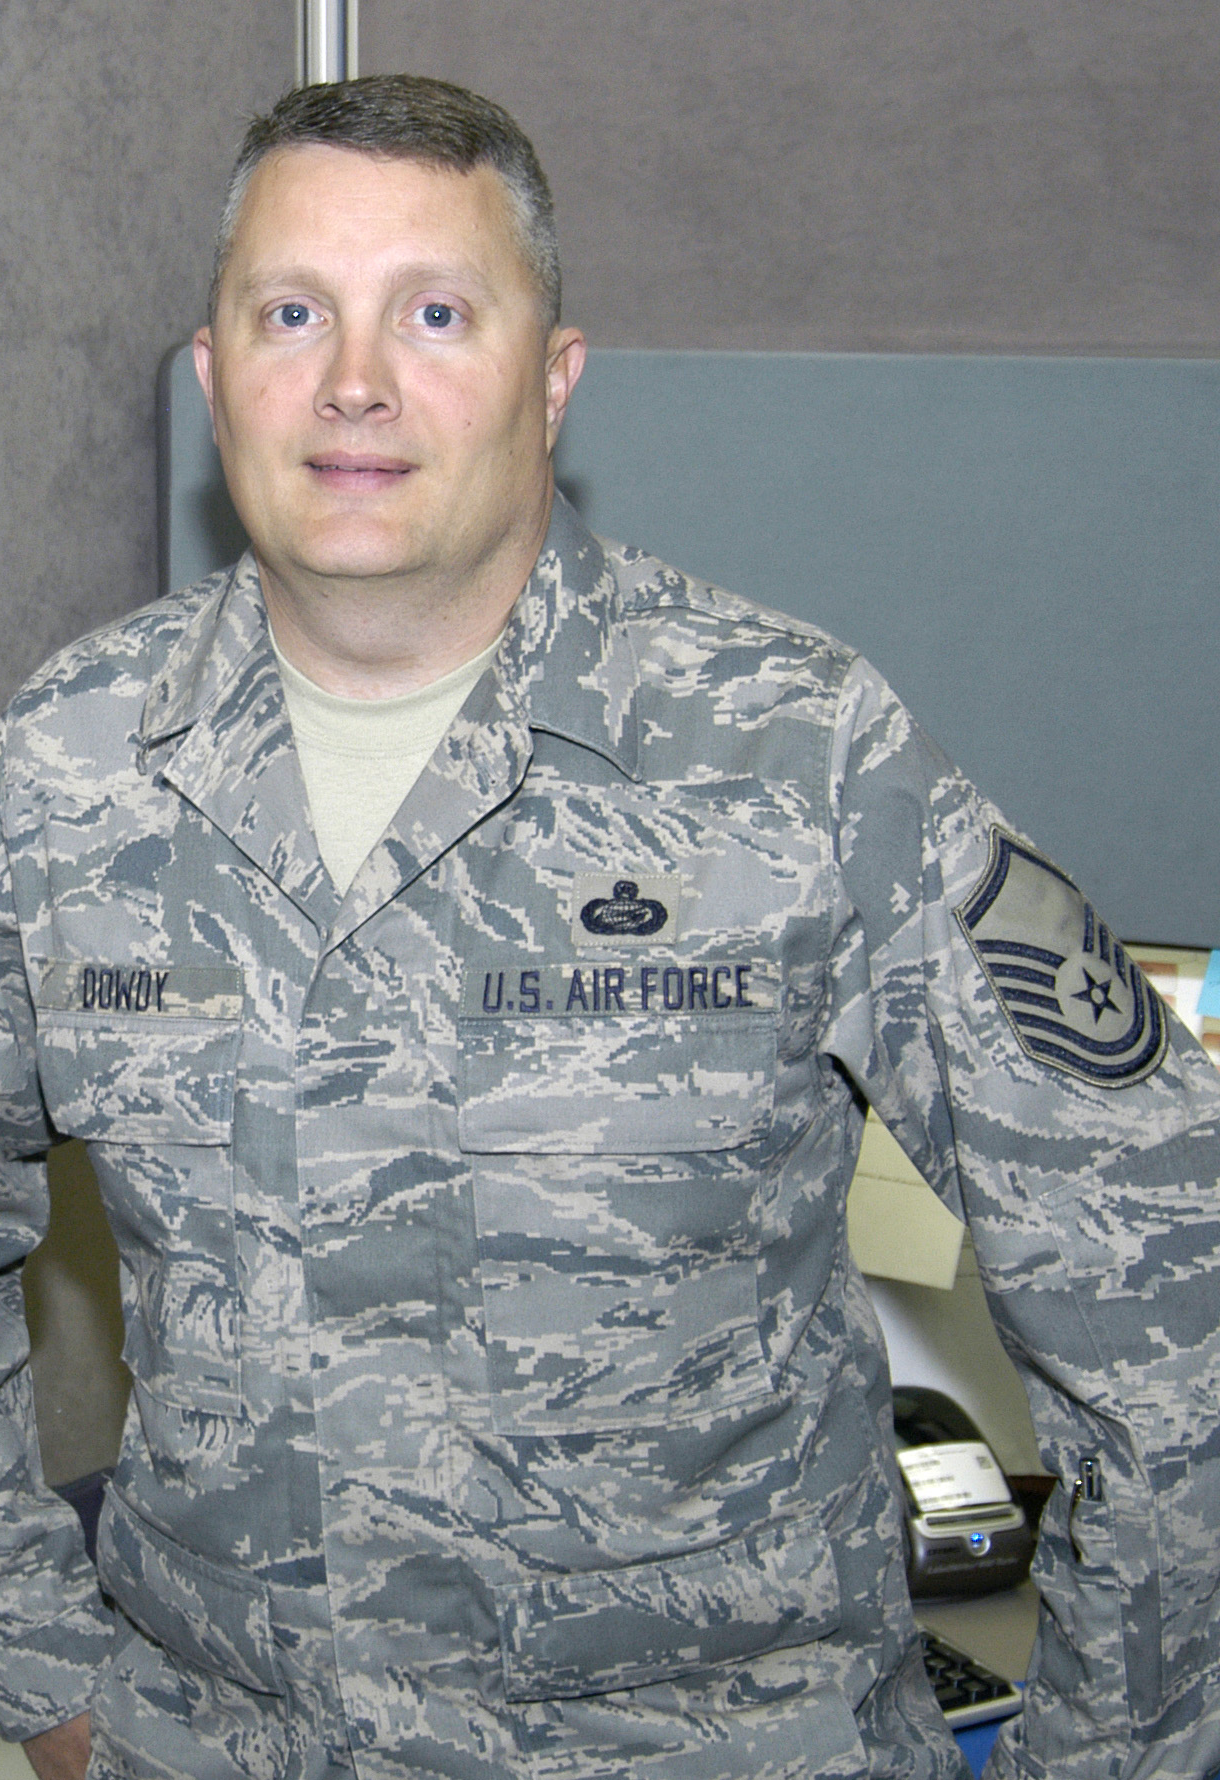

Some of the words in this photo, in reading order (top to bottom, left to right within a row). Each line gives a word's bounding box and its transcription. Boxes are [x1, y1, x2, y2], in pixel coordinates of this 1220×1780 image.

[82, 968, 171, 1012] DOWDY
[482, 970, 552, 1013] U.S.
[566, 967, 625, 1011] AIR
[640, 964, 753, 1010] FORCE
